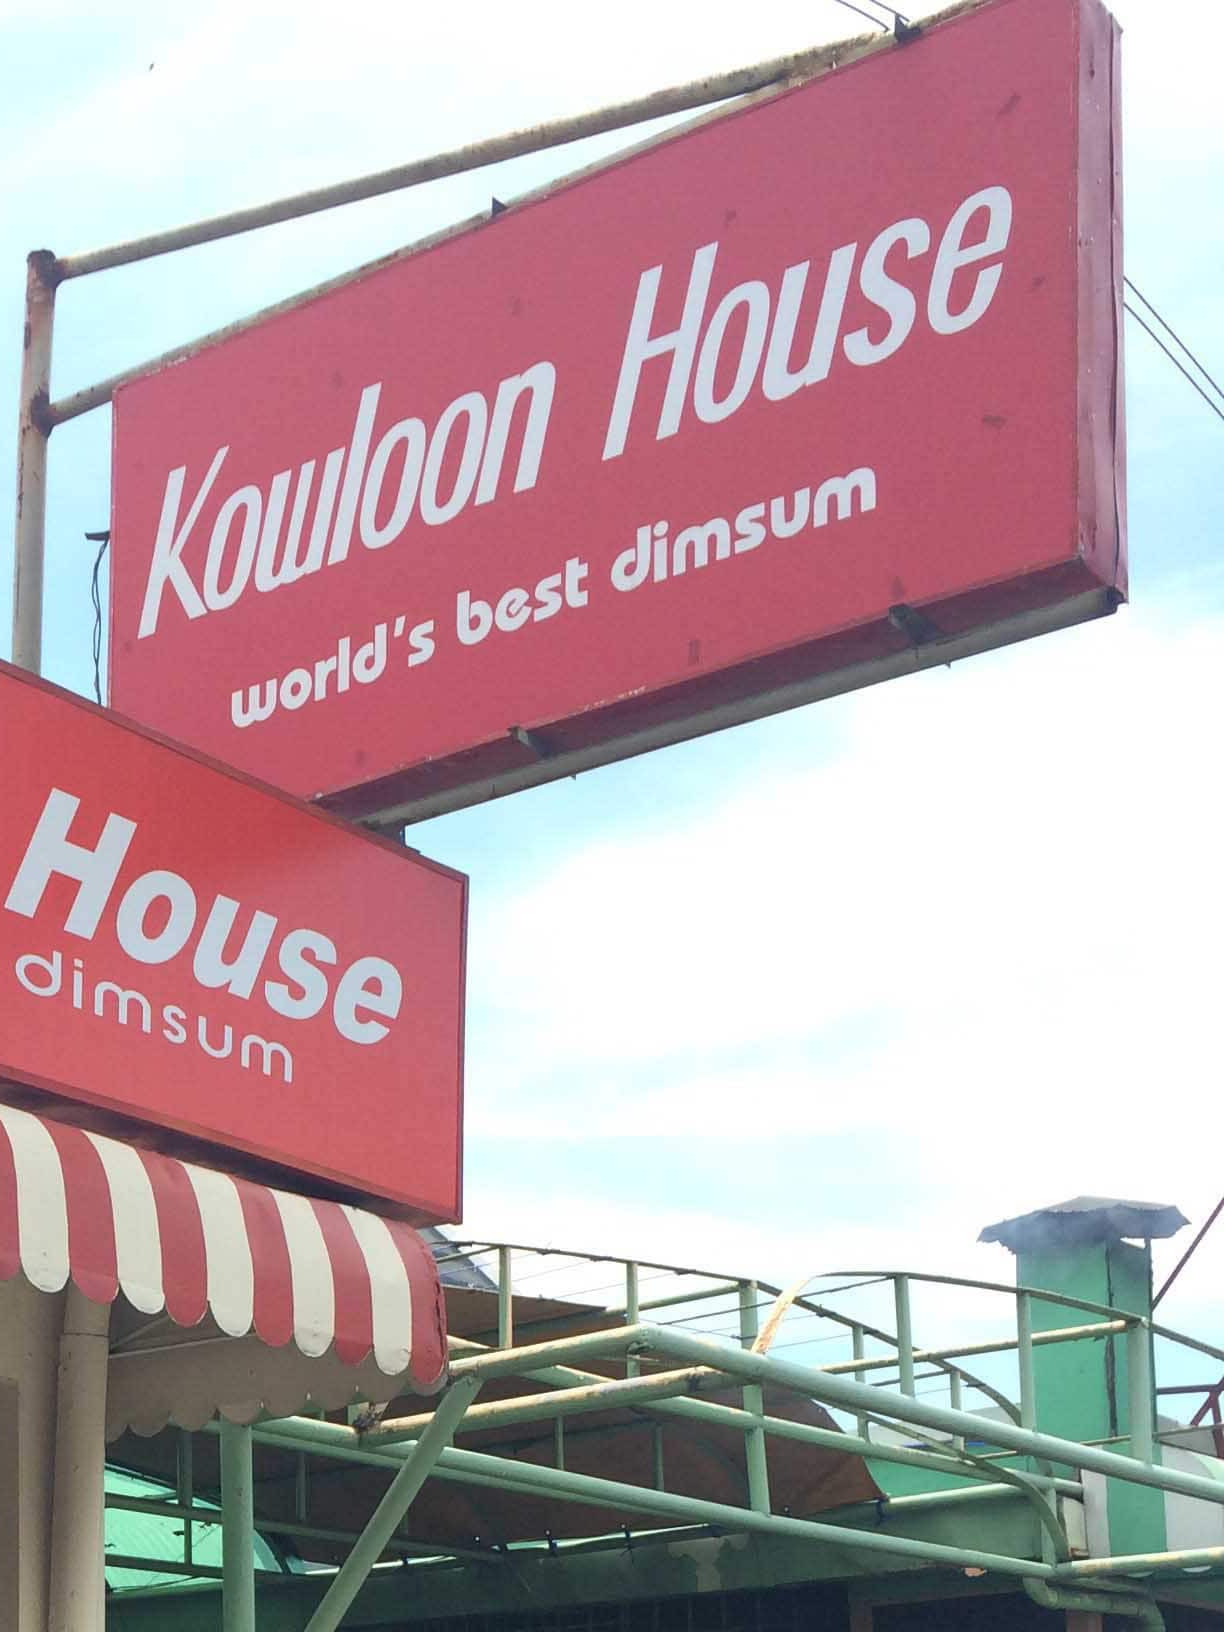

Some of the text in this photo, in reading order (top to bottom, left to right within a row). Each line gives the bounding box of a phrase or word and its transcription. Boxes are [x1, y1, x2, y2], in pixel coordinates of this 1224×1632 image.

[137, 186, 1013, 639] Kowloon House
[231, 467, 878, 728] world's best dimsum
[4, 788, 403, 1044] House
[15, 950, 293, 1082] dimsum
